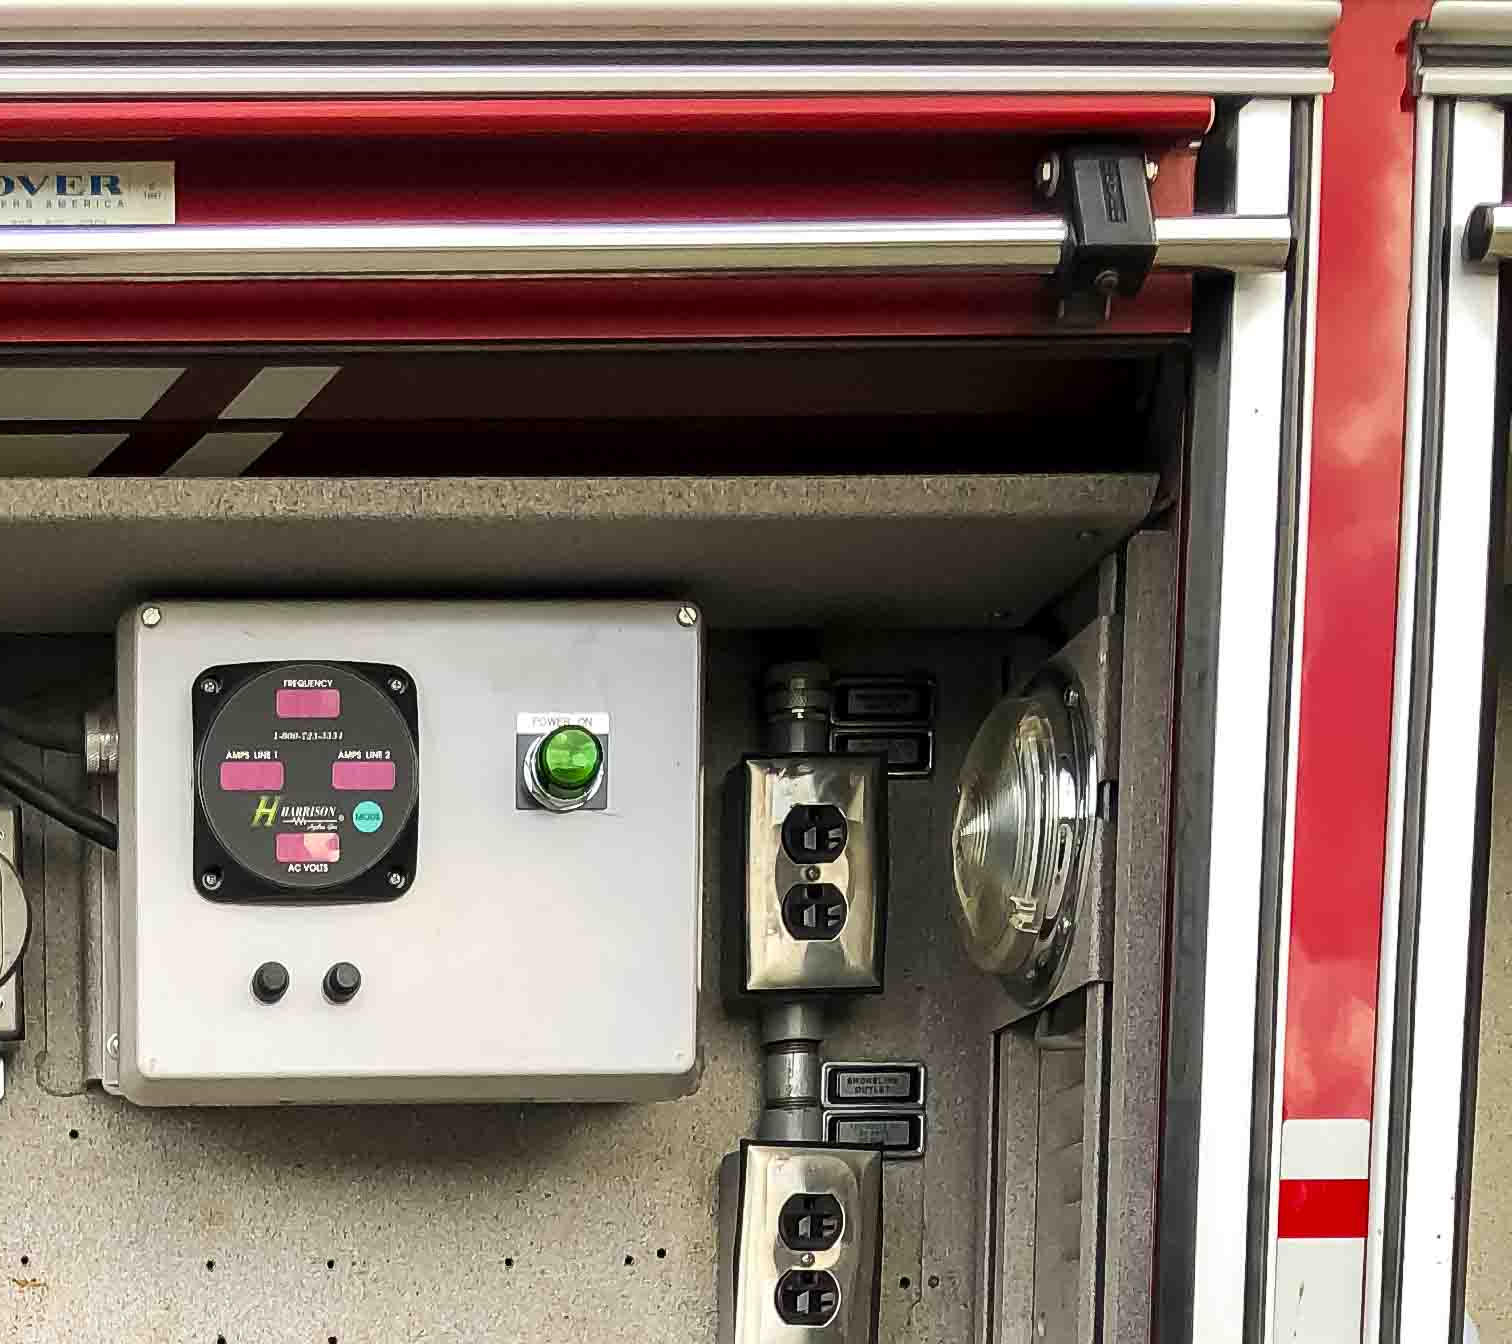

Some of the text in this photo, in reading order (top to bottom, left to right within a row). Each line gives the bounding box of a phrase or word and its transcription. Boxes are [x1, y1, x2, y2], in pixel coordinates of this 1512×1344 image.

[46, 200, 125, 209] AMERICA
[283, 679, 333, 688] FREQUENCY
[225, 750, 250, 760] AMPS
[280, 806, 336, 817] HARRISON
[288, 863, 329, 873] AC VOLTS
